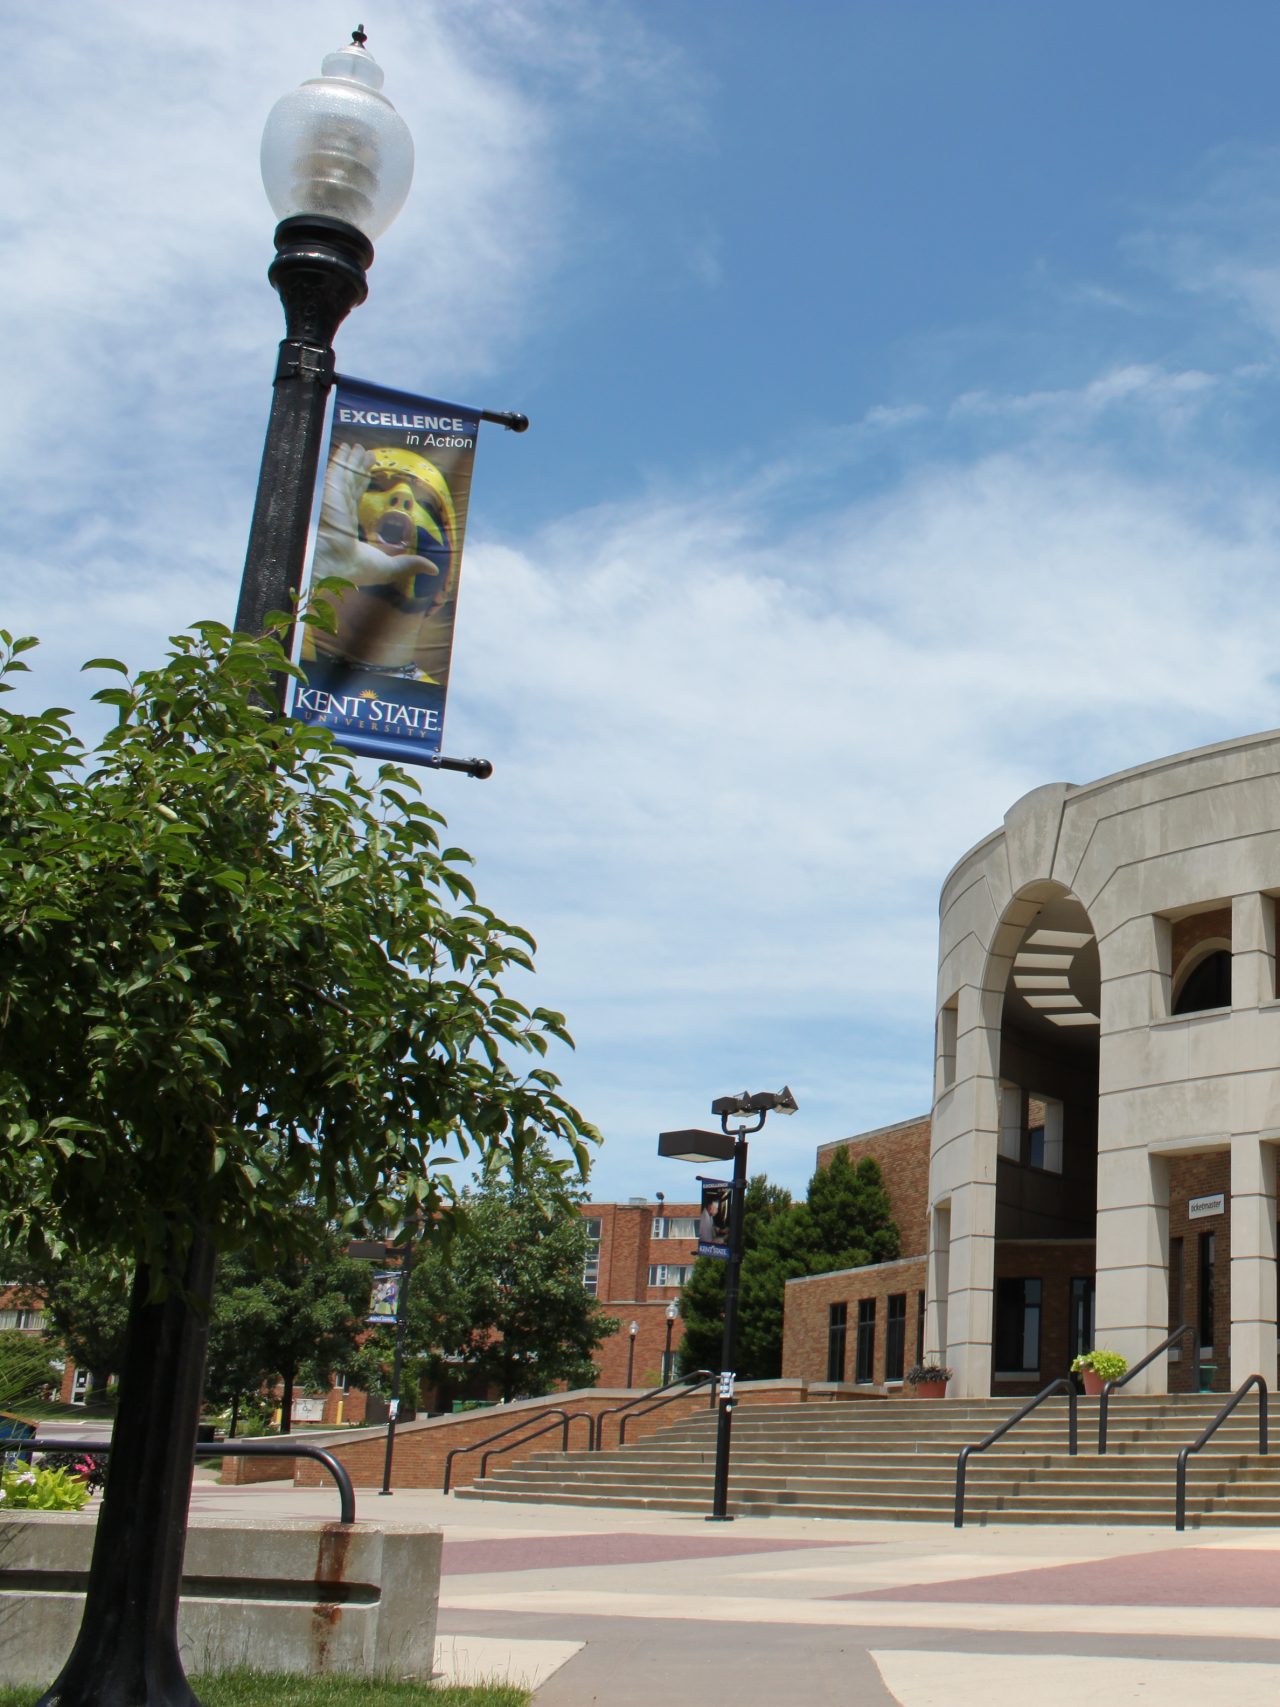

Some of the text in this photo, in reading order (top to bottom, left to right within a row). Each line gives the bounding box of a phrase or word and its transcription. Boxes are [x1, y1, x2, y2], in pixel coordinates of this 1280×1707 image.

[339, 409, 464, 431] EXCELLENCE
[406, 431, 473, 449] in Action
[295, 687, 367, 718] KENT
[304, 711, 428, 738] UNIVERSITY
[1191, 1200, 1221, 1211] ticketmaster
